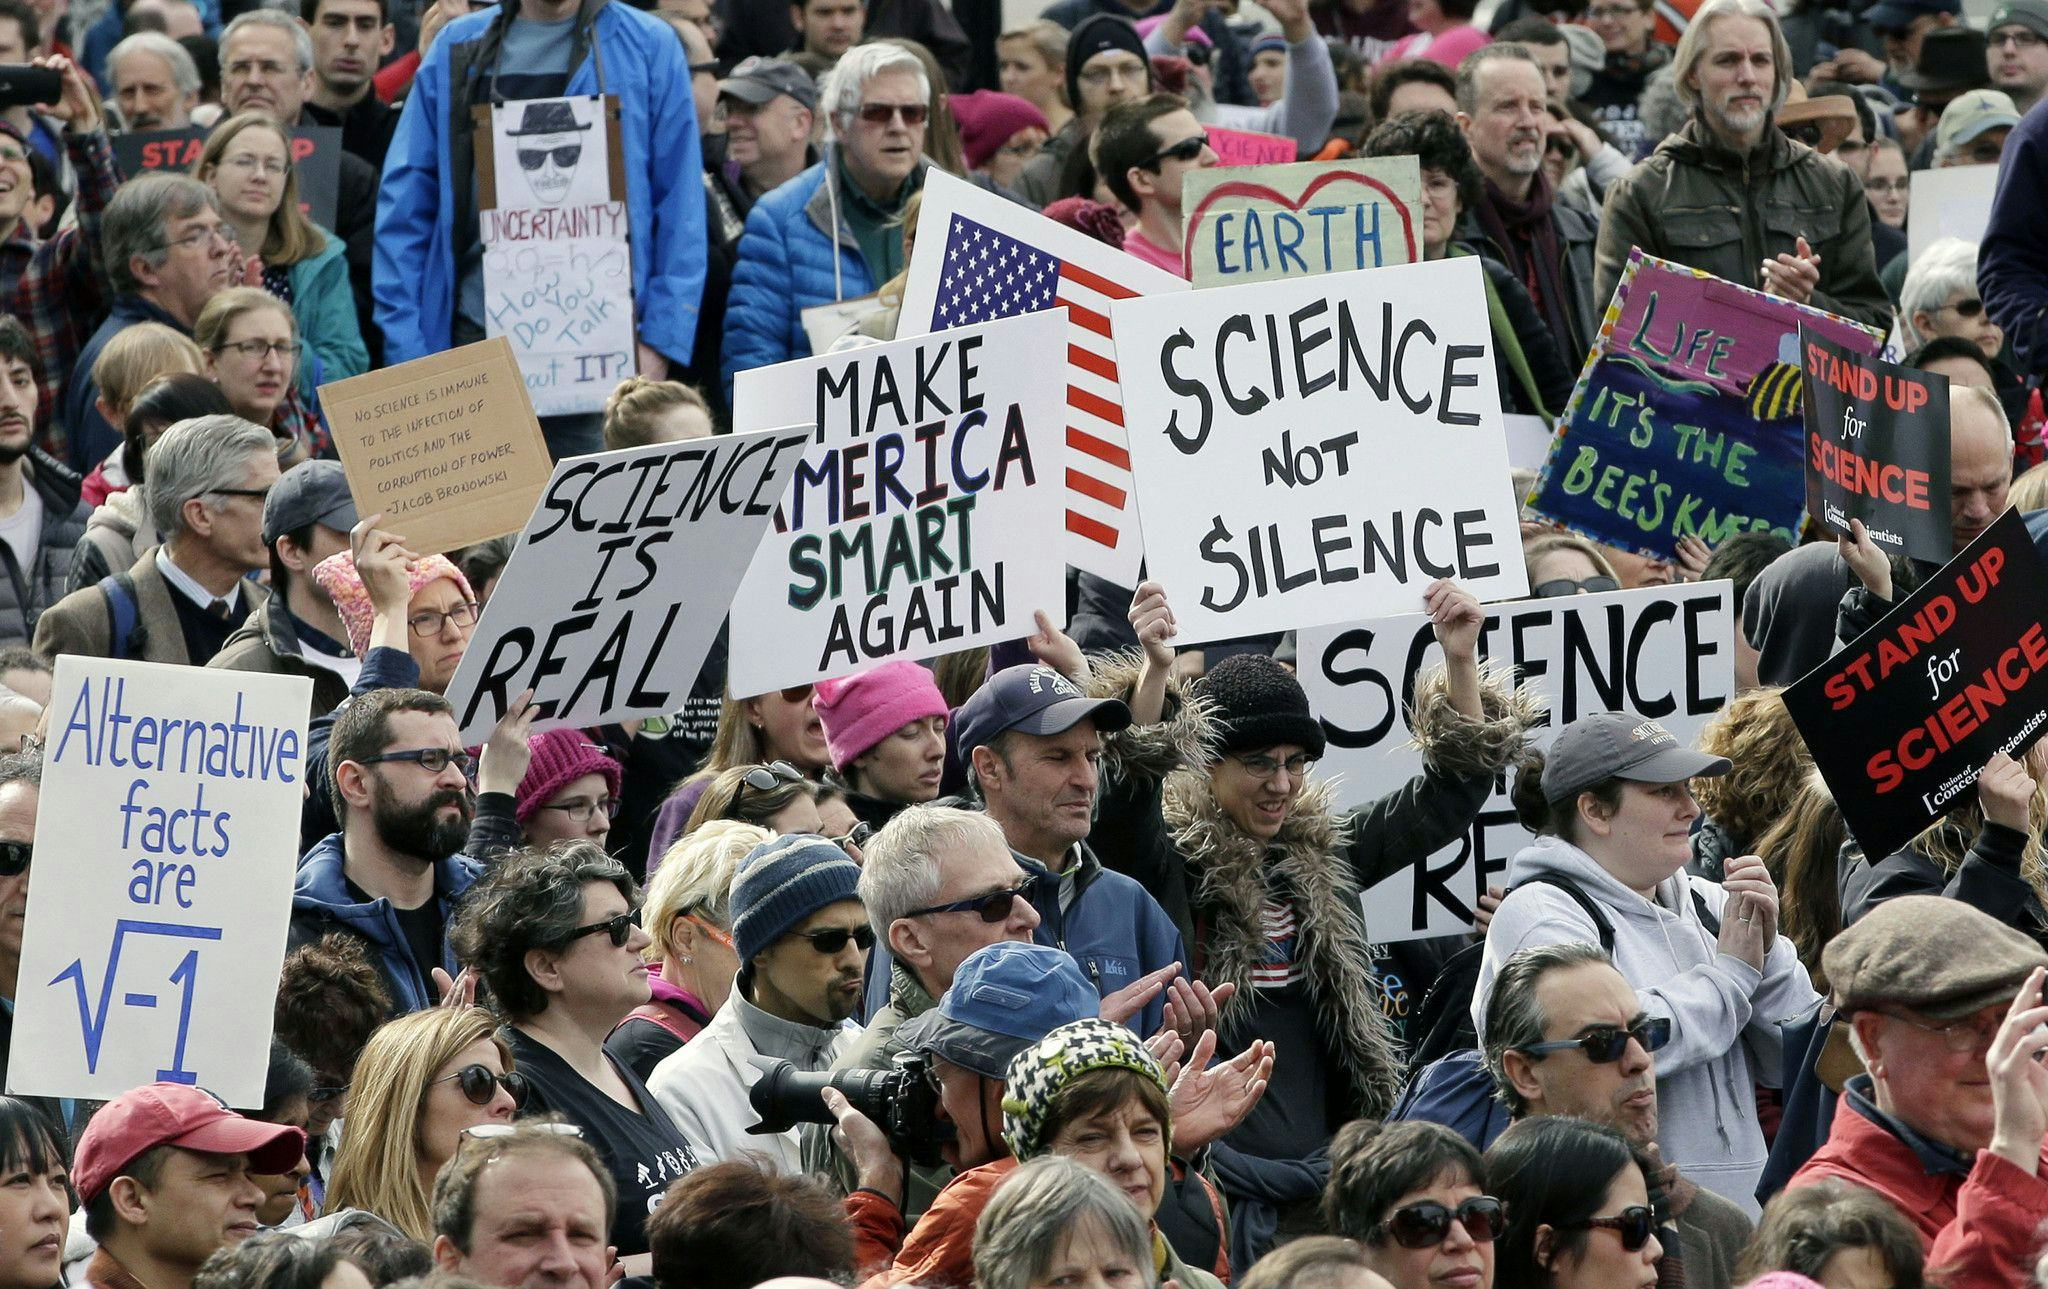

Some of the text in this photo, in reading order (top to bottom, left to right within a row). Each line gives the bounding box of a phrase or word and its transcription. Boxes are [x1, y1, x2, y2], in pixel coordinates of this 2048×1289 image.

[141, 136, 315, 168] STA P
[482, 202, 622, 243] UNCERTAINTY
[1215, 201, 1382, 274] EARTH
[486, 273, 560, 329] How
[514, 278, 594, 349] Do You
[556, 298, 615, 346] Talk
[1630, 290, 1735, 380] LIFE
[355, 373, 489, 423] NO SCIENCE IS IMMUNE
[525, 351, 629, 388] out IT?
[816, 335, 985, 444] MAKE
[1160, 298, 1485, 455] SCIENCE
[1807, 342, 1928, 414] STAND UP
[360, 399, 484, 448] TO THE INFECTION OF
[369, 429, 472, 471] POLITICS AND THE
[1261, 429, 1359, 489] NOT
[1588, 386, 1757, 487] IT'S THE
[1841, 406, 1867, 440] for
[377, 442, 515, 494] CORRUPTION OF POWER
[438, 470, 508, 501] BRONOWSKI
[528, 434, 810, 545] SCIENCE
[1562, 445, 1672, 532] BEE'S
[1811, 431, 1930, 510] SCIENCE
[571, 531, 674, 611] IS
[788, 493, 977, 611] SMART
[1200, 507, 1500, 613] SILENCE
[1866, 525, 1903, 545] ientists
[818, 561, 1005, 672] AGAIN
[1823, 546, 2005, 711] STAND UP
[459, 603, 682, 732] REAL
[1925, 648, 1960, 701] for
[54, 676, 299, 784] Alternative
[1865, 621, 2048, 794] SCIENCE
[1939, 764, 1972, 792] Union of
[119, 778, 230, 858] facts
[128, 858, 196, 909] are
